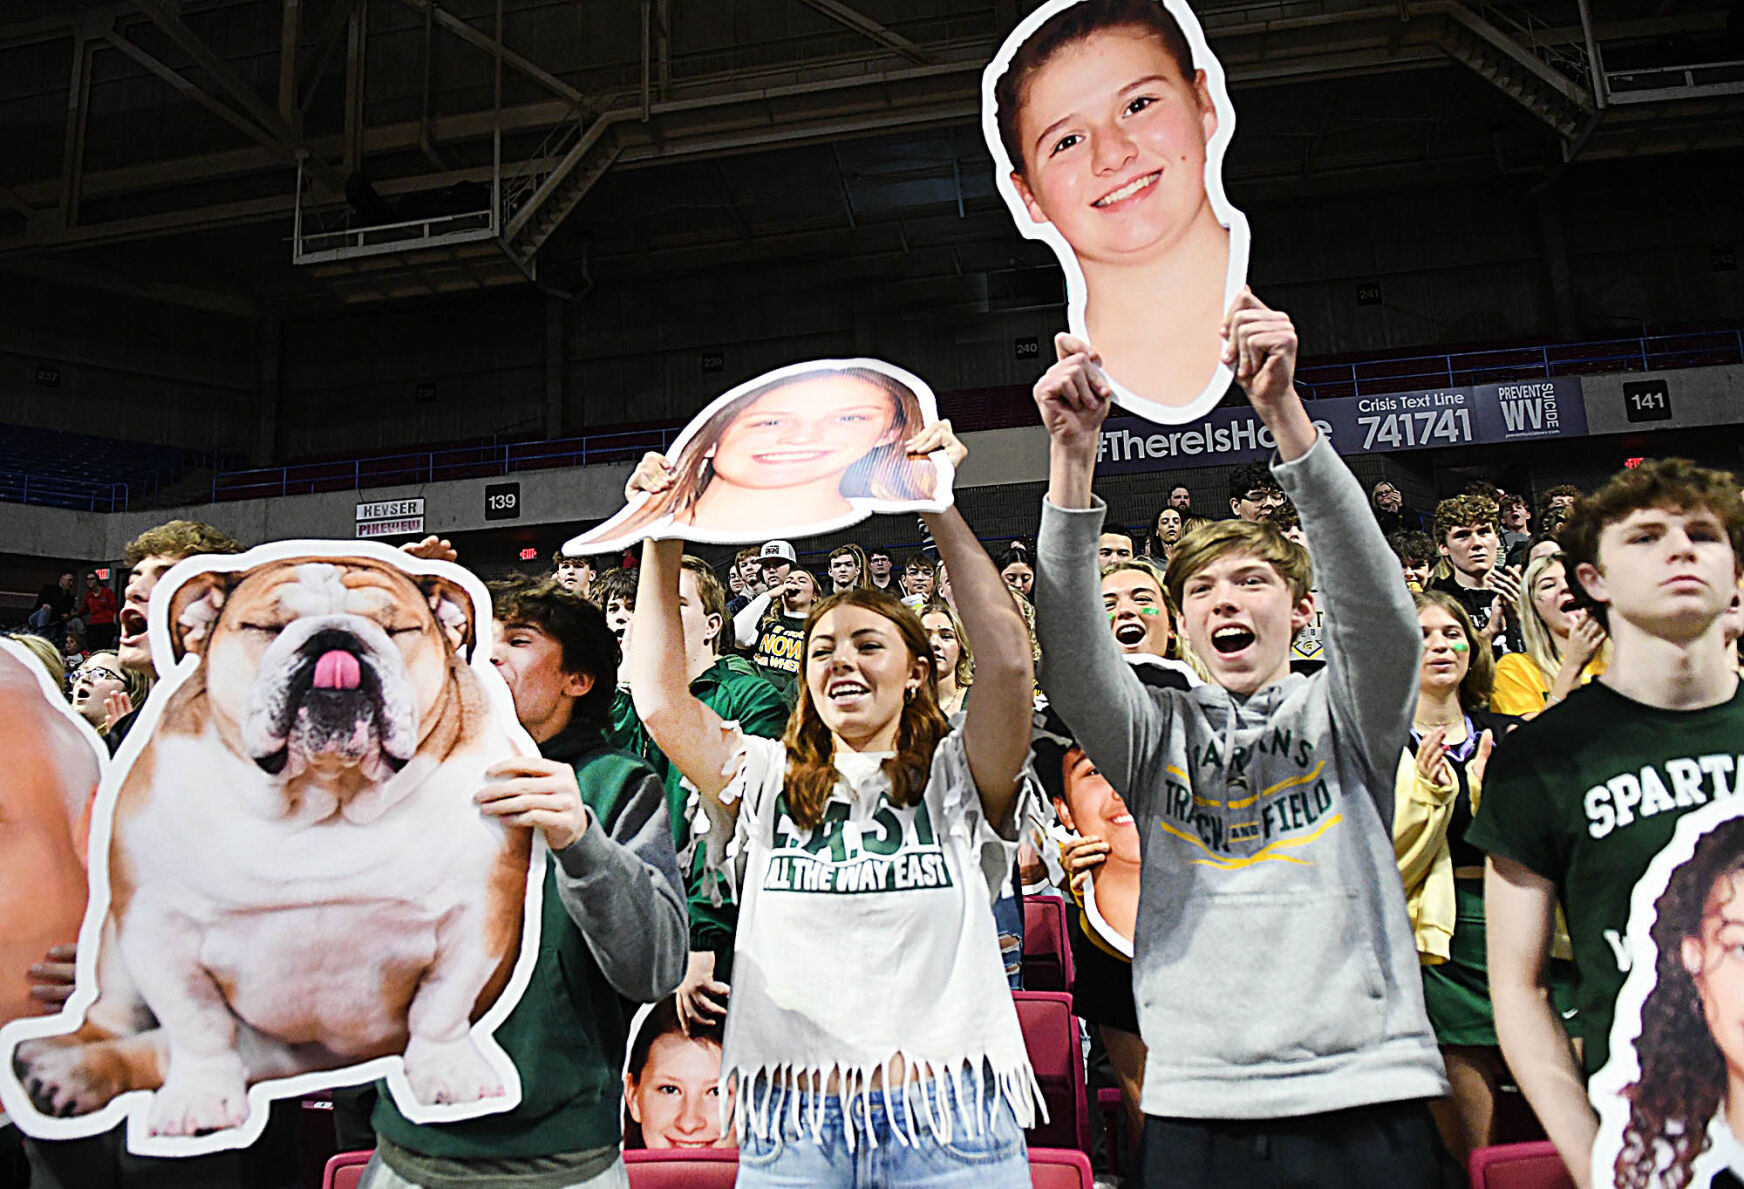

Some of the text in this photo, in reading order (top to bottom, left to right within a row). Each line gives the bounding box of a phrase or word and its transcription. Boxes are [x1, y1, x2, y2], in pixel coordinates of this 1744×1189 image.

[1016, 343, 1038, 355] 240
[1358, 392, 1465, 413] Crisis Text Line
[1498, 384, 1541, 400] PREVENT
[1541, 383, 1559, 428] SUICIDE
[1631, 392, 1665, 410] 141
[1358, 408, 1472, 450] 741741
[1500, 398, 1542, 431] WV
[1096, 419, 1333, 462] #ThereIsHoe
[363, 501, 417, 517] KEYSER
[488, 493, 516, 510] 139
[1231, 825, 1259, 838] AND
[1261, 778, 1332, 840] FIELD
[1584, 753, 1744, 839] SPART
[793, 858, 836, 890] THE
[835, 860, 890, 891] WAY
[892, 854, 949, 888] EAST
